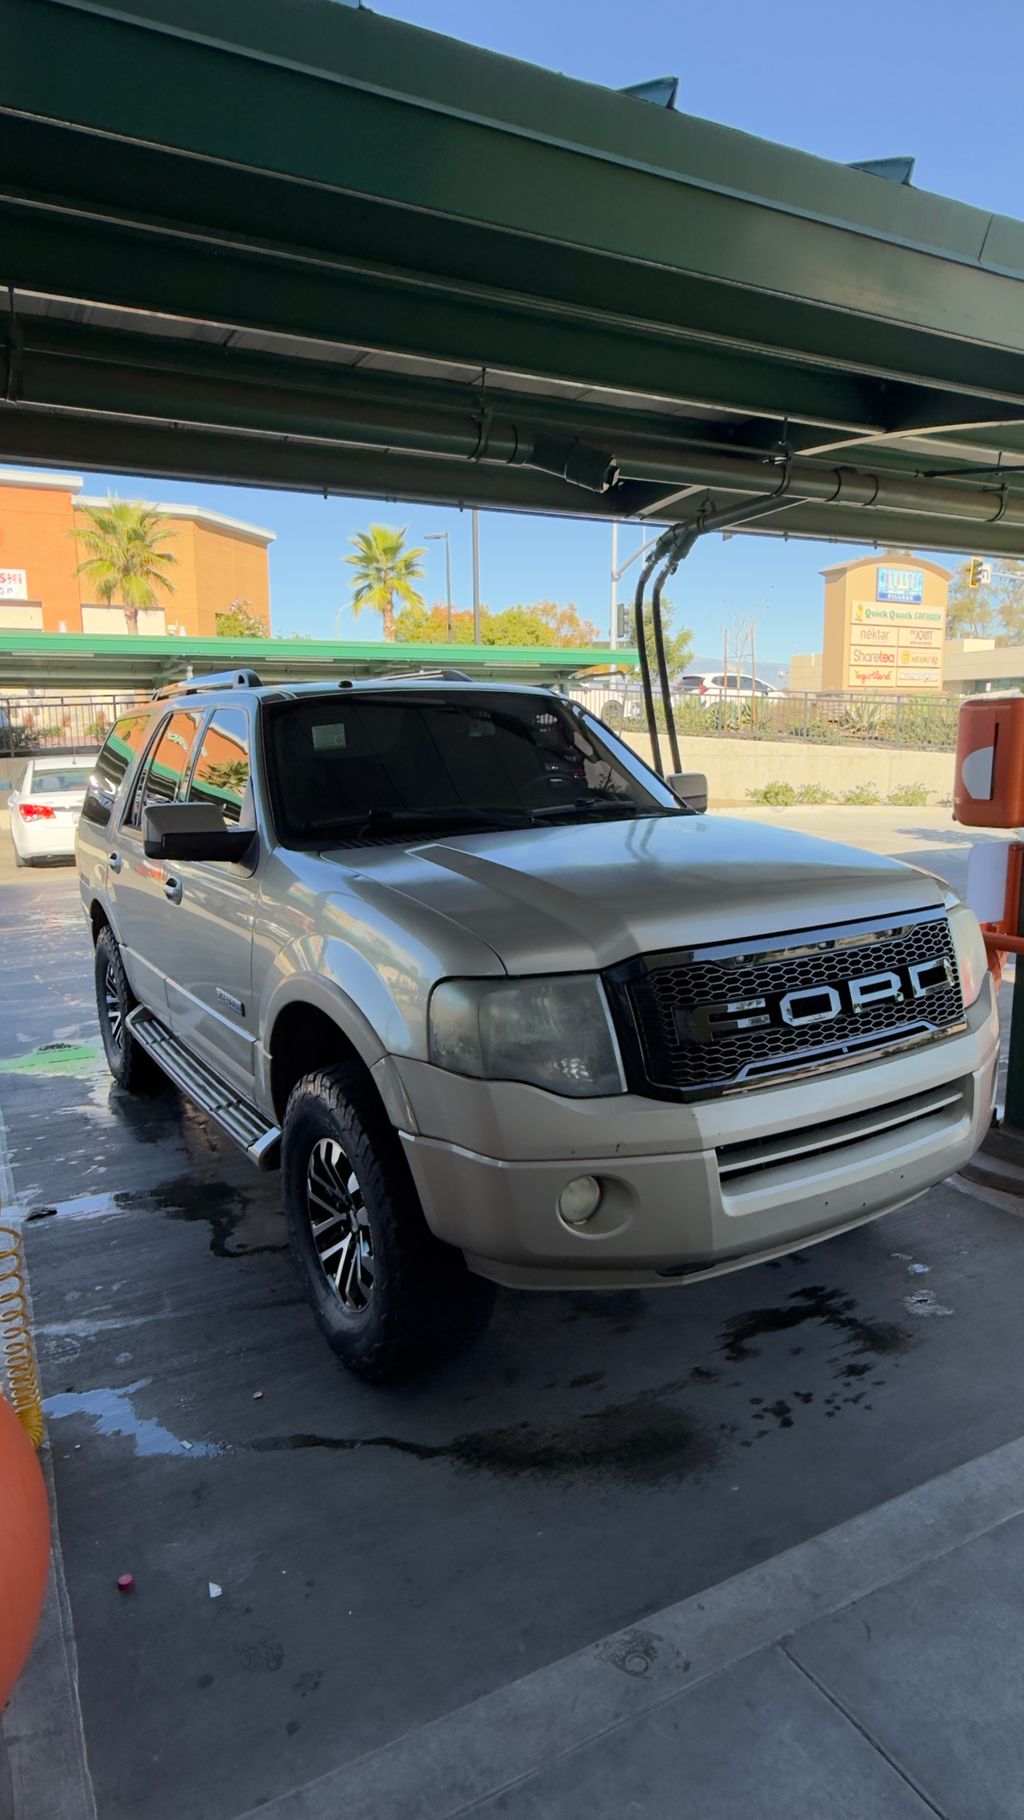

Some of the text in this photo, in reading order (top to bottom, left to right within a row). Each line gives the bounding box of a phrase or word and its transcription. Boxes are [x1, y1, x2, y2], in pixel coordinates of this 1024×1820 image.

[865, 608, 888, 618] Quick
[889, 610, 912, 620] Quack
[854, 649, 895, 663] Sharetea
[677, 958, 955, 1044] FORD
